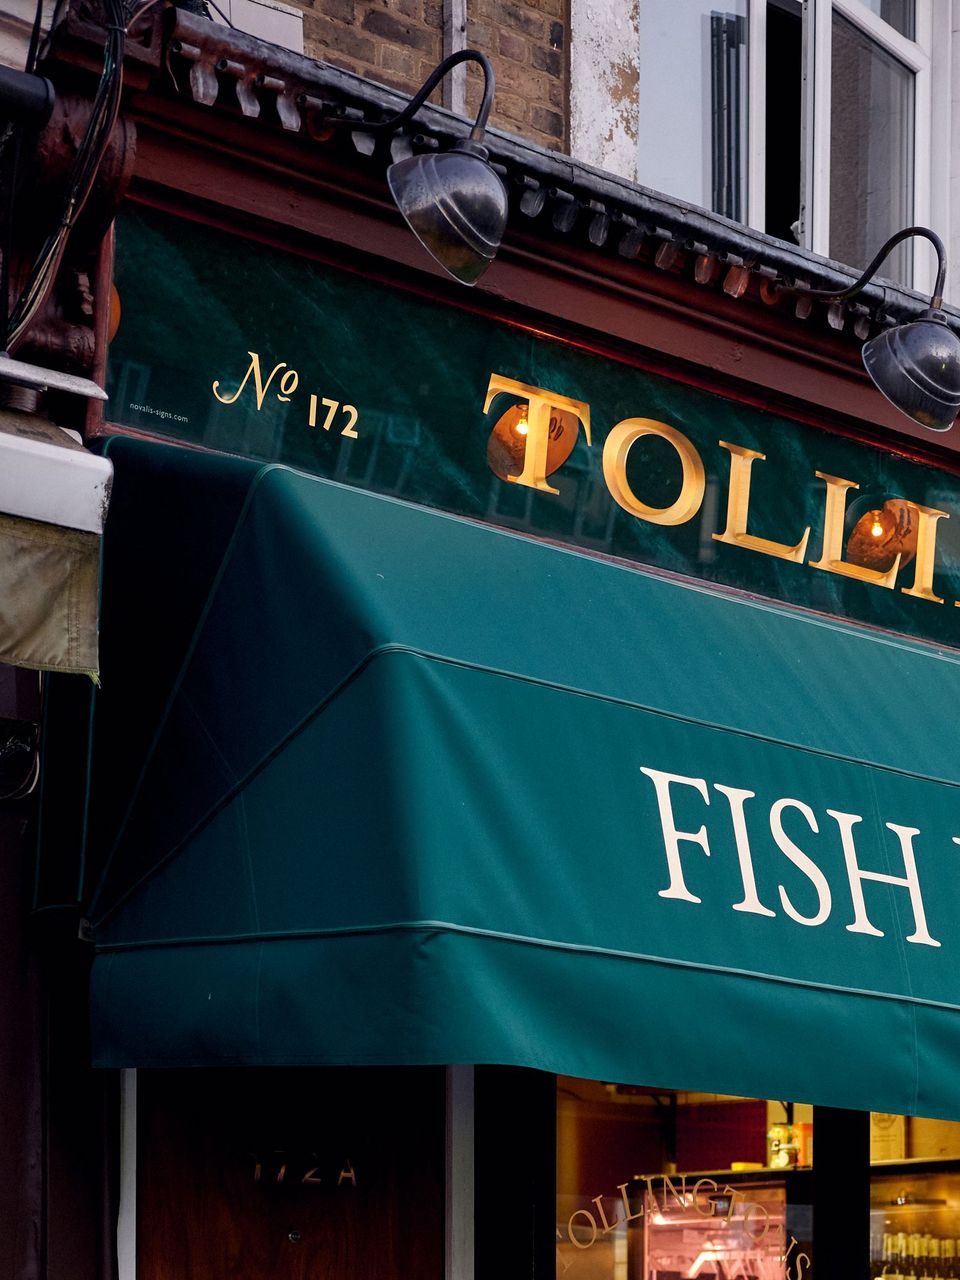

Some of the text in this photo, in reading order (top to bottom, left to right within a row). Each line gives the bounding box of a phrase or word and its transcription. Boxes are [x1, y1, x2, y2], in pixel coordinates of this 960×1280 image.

[130, 402, 188, 423] novalis-signs.com
[308, 394, 359, 439] 172
[640, 766, 941, 947] FISH
